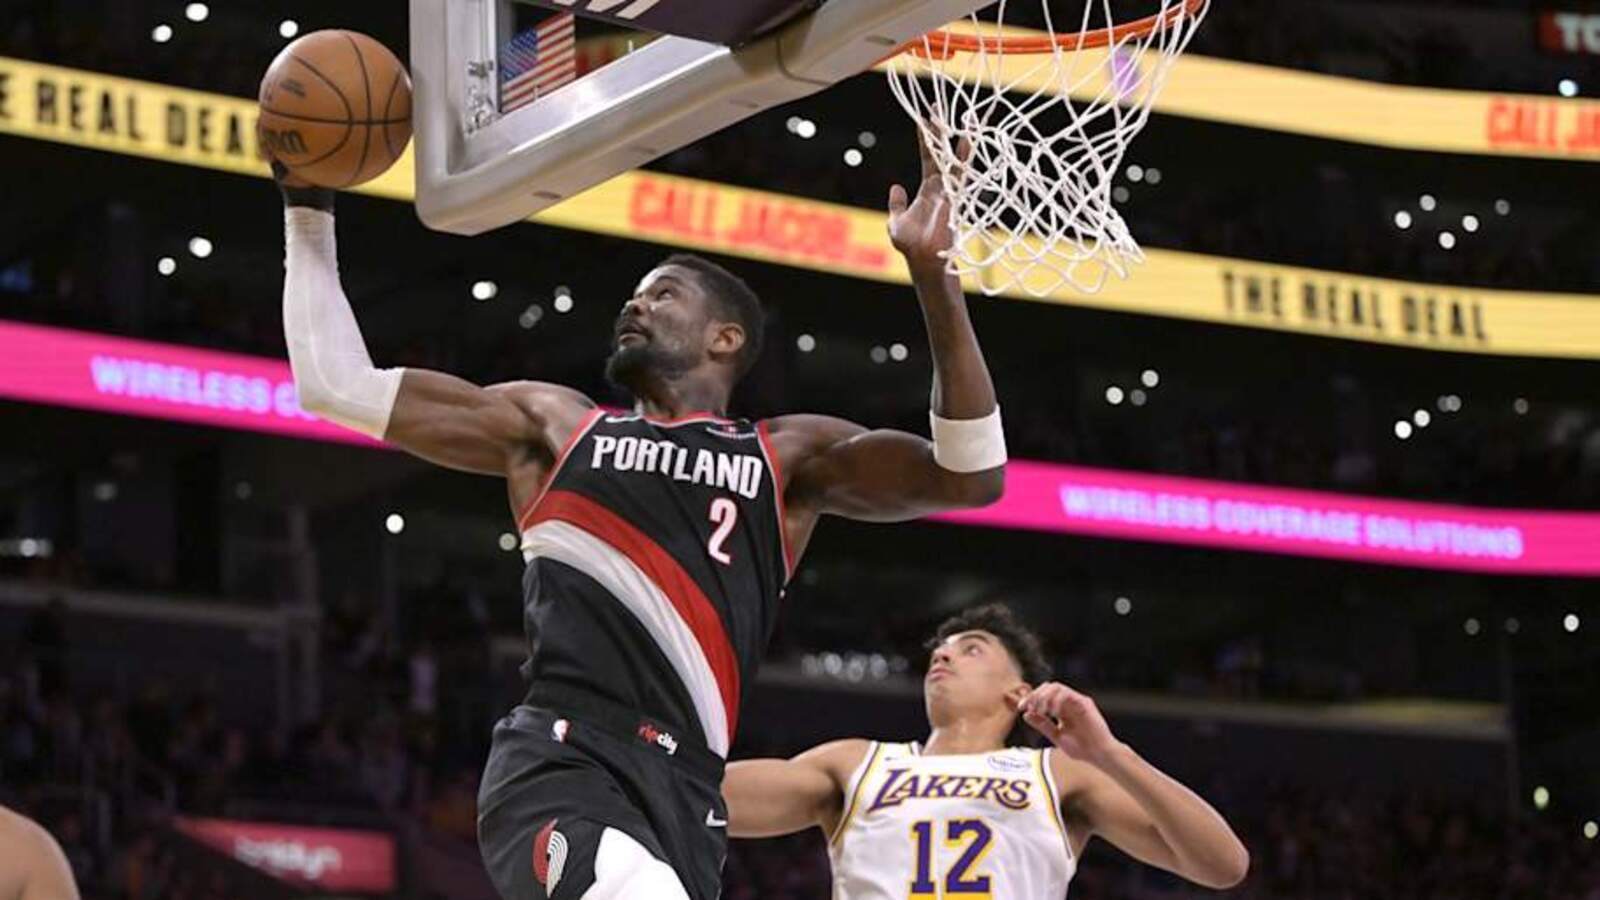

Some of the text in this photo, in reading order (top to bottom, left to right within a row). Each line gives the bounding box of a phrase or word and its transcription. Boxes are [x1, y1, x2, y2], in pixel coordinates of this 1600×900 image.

[37, 79, 143, 141] REAL
[167, 102, 245, 156] DEA
[1223, 271, 1486, 340] THE REAL DEAL
[90, 354, 271, 414] WIRELESS
[590, 434, 764, 500] PORTLAND
[707, 497, 738, 566] 2
[1060, 484, 1524, 560] WIRELESS COVERAGE SOLUTIONS
[866, 767, 1032, 814] LAKERS
[909, 818, 994, 895] 12
